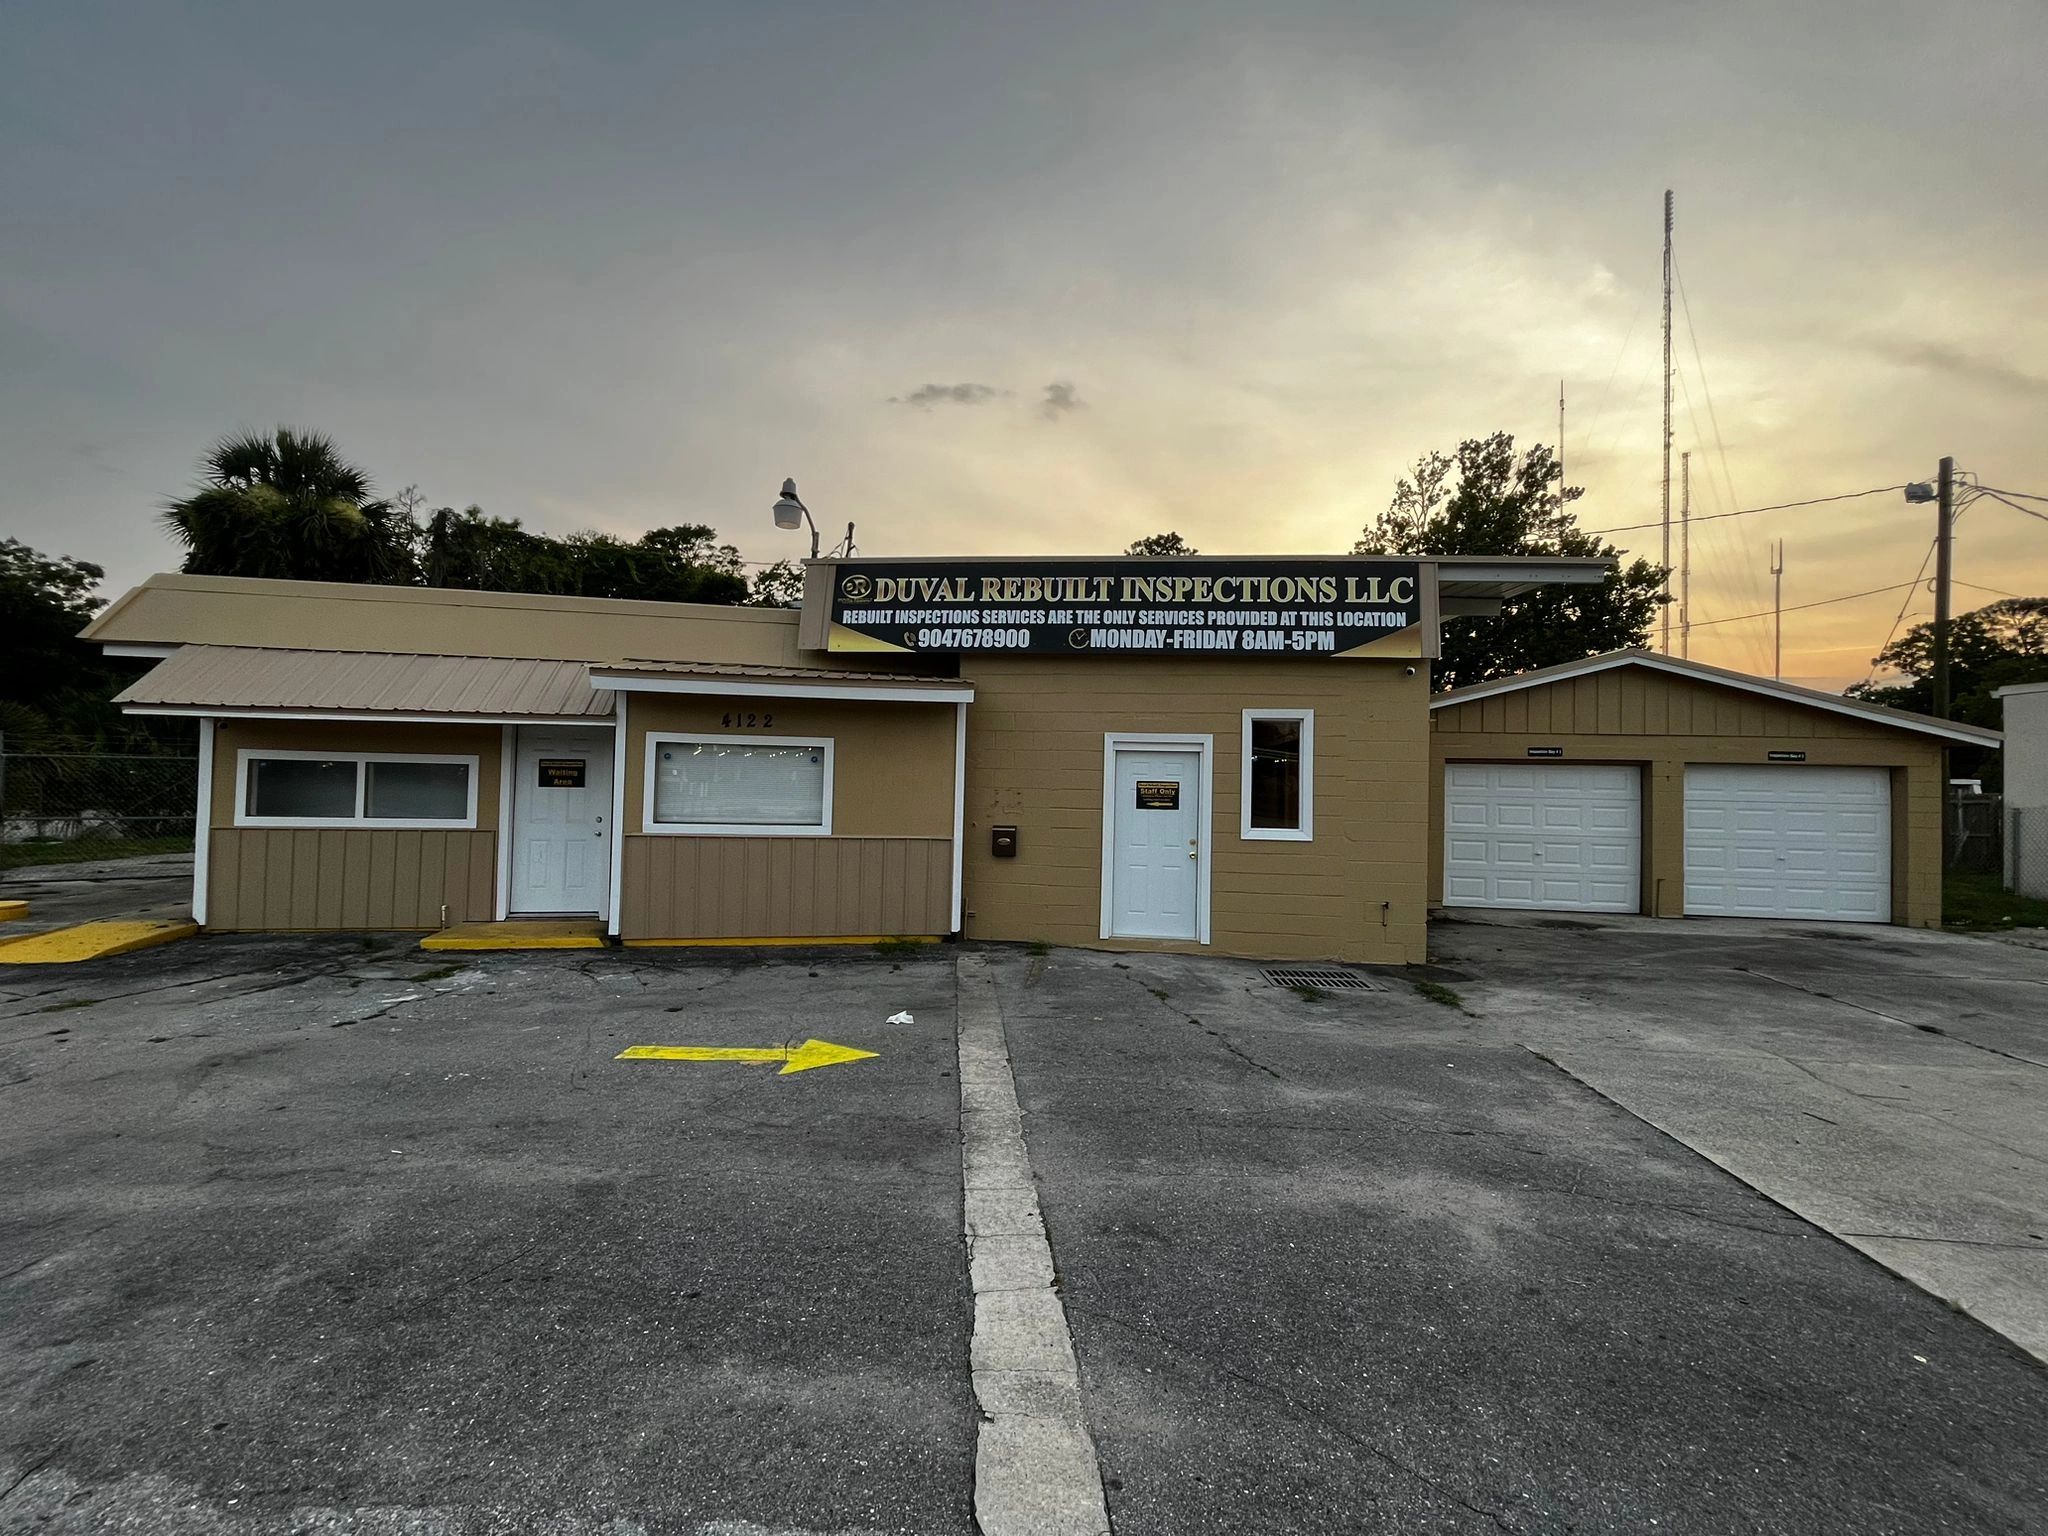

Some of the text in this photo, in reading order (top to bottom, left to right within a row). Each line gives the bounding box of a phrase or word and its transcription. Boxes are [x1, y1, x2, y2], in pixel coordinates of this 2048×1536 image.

[874, 577, 975, 602] DUVAL
[979, 577, 1114, 602] REBUILT
[1120, 576, 1338, 604] INSPECTIONS
[1344, 576, 1414, 604] LLC
[842, 609, 1407, 627] REBUILT INSPECTIONS SERVICES ARE THE ONLY SERVICES PROVIDED AT THIS LOCATION
[918, 628, 1335, 650] 9047678900 MONDAY-FRIDAY 8AM-5PM
[721, 712, 773, 728] 4122
[547, 769, 578, 777] Waiting
[1159, 788, 1176, 796] Only
